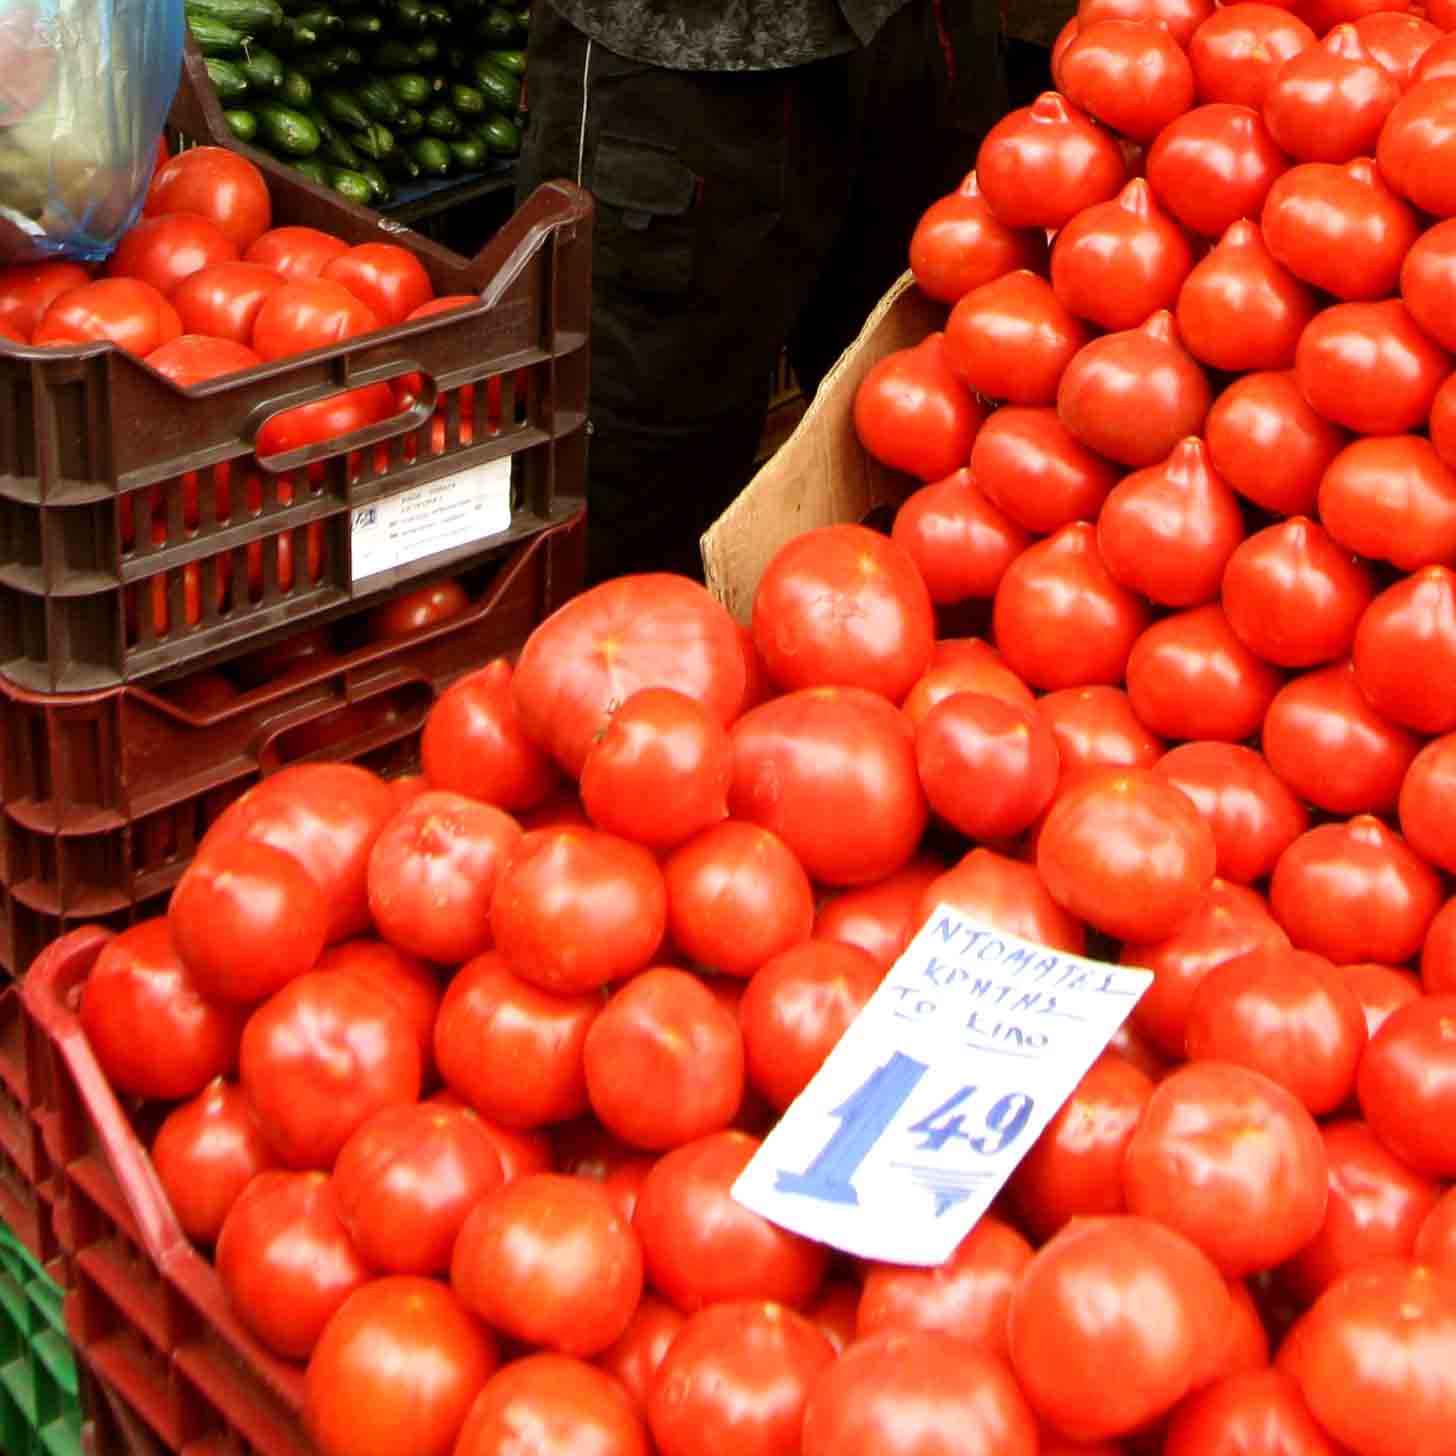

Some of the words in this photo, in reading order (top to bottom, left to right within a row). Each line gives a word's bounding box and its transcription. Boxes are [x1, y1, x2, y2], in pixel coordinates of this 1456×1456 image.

[922, 955, 1088, 1022] ΚΡΗΤΗΣ
[930, 915, 1137, 996] ΝΤΟΜΑΤΕΣ
[891, 985, 937, 1016] ΤΟ
[773, 1050, 930, 1206] 1
[907, 1084, 1035, 1156] 49
